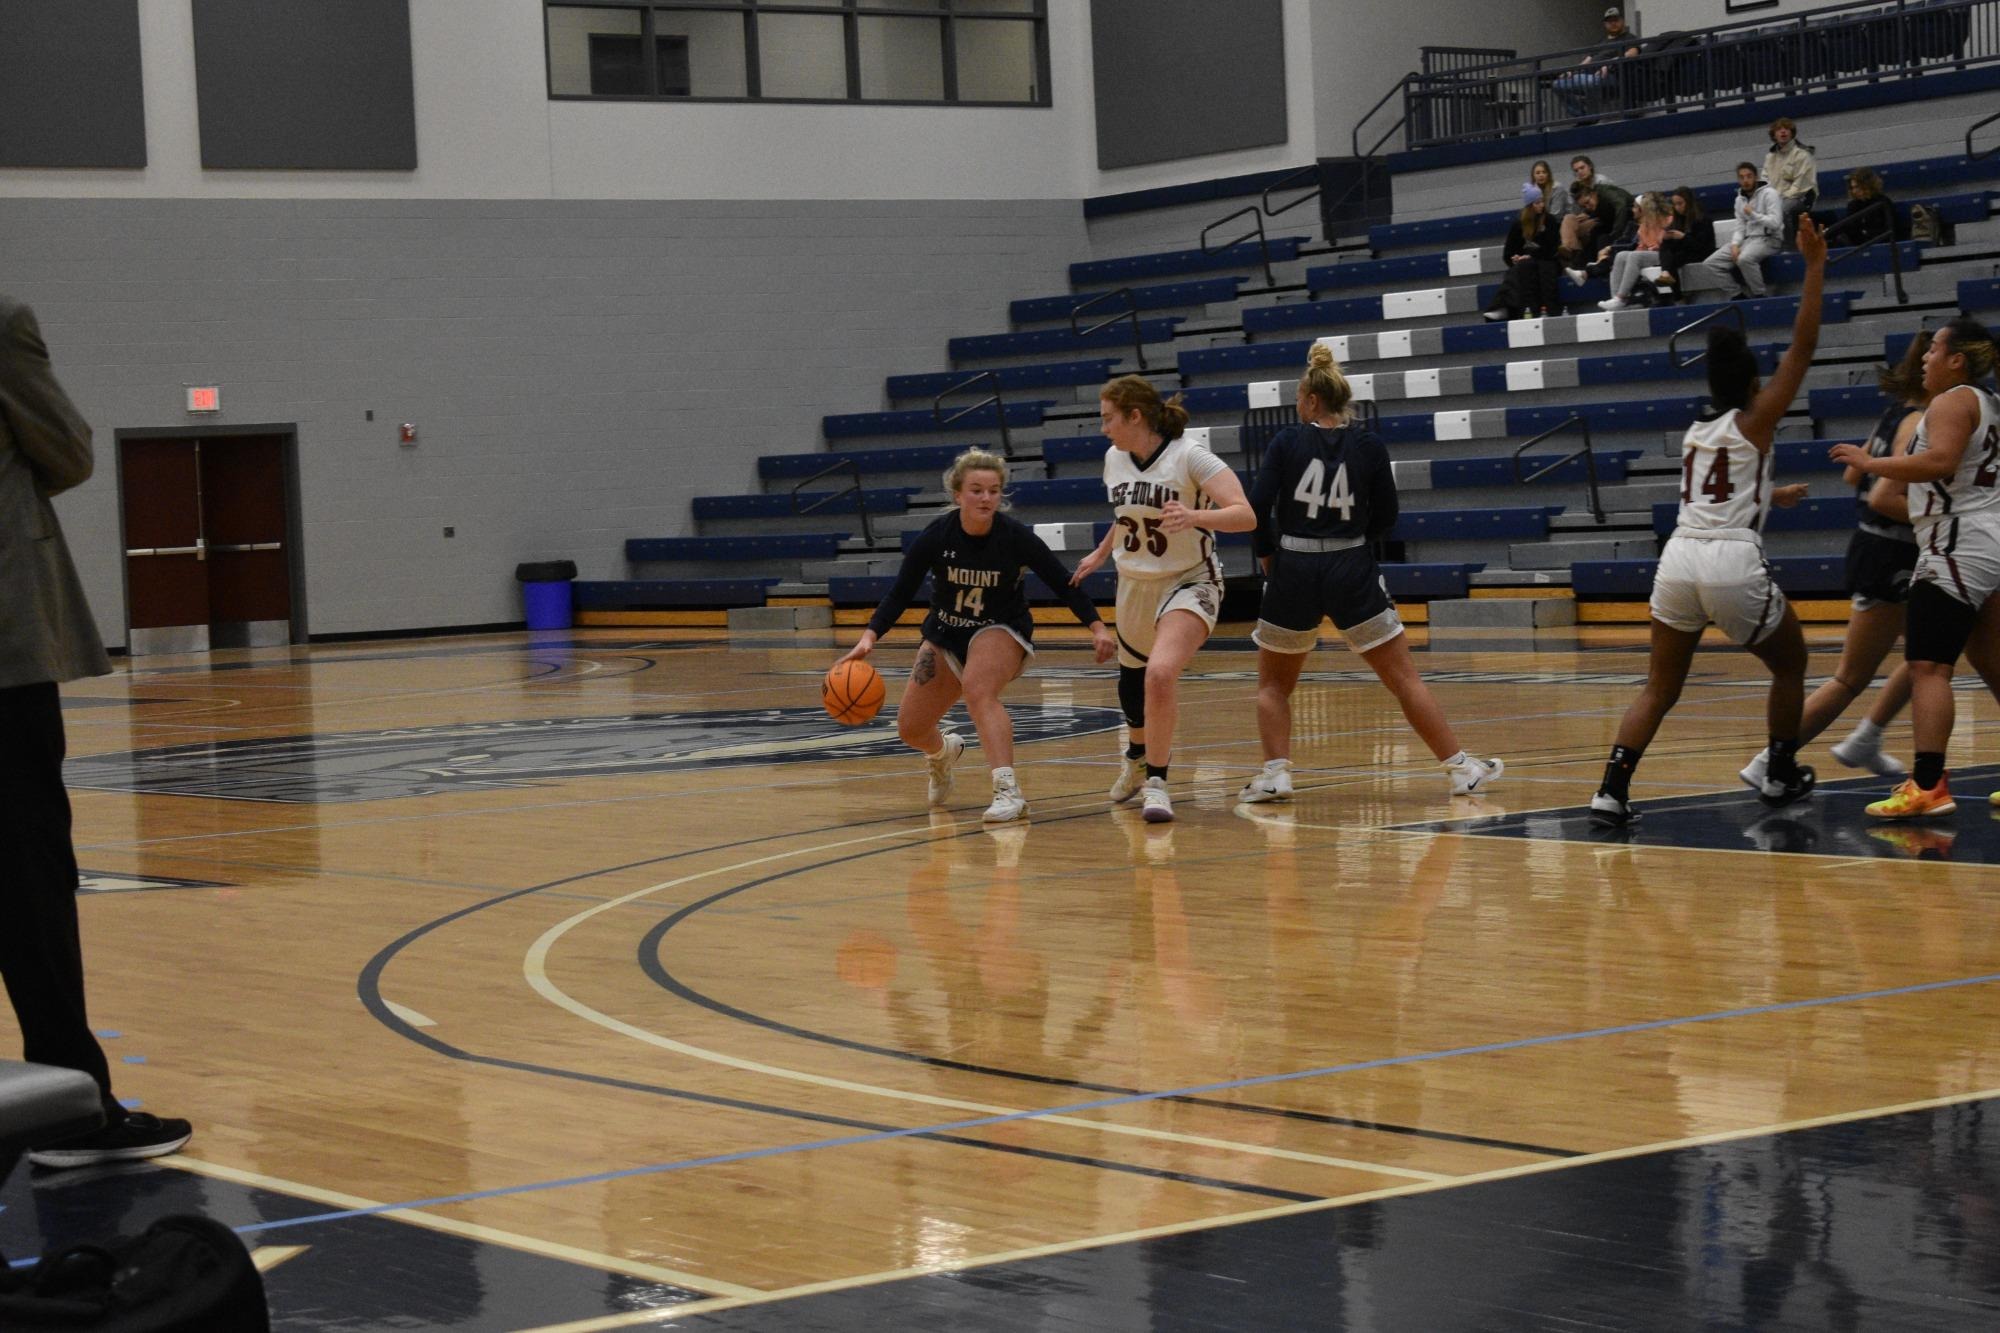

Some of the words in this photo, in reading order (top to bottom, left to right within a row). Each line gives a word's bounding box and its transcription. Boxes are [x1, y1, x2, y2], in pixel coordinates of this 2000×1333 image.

[1294, 457, 1355, 520] 44
[1681, 446, 1735, 505] 14
[1116, 516, 1168, 557] 35
[947, 566, 1001, 587] MOUNT
[954, 587, 985, 617] 14
